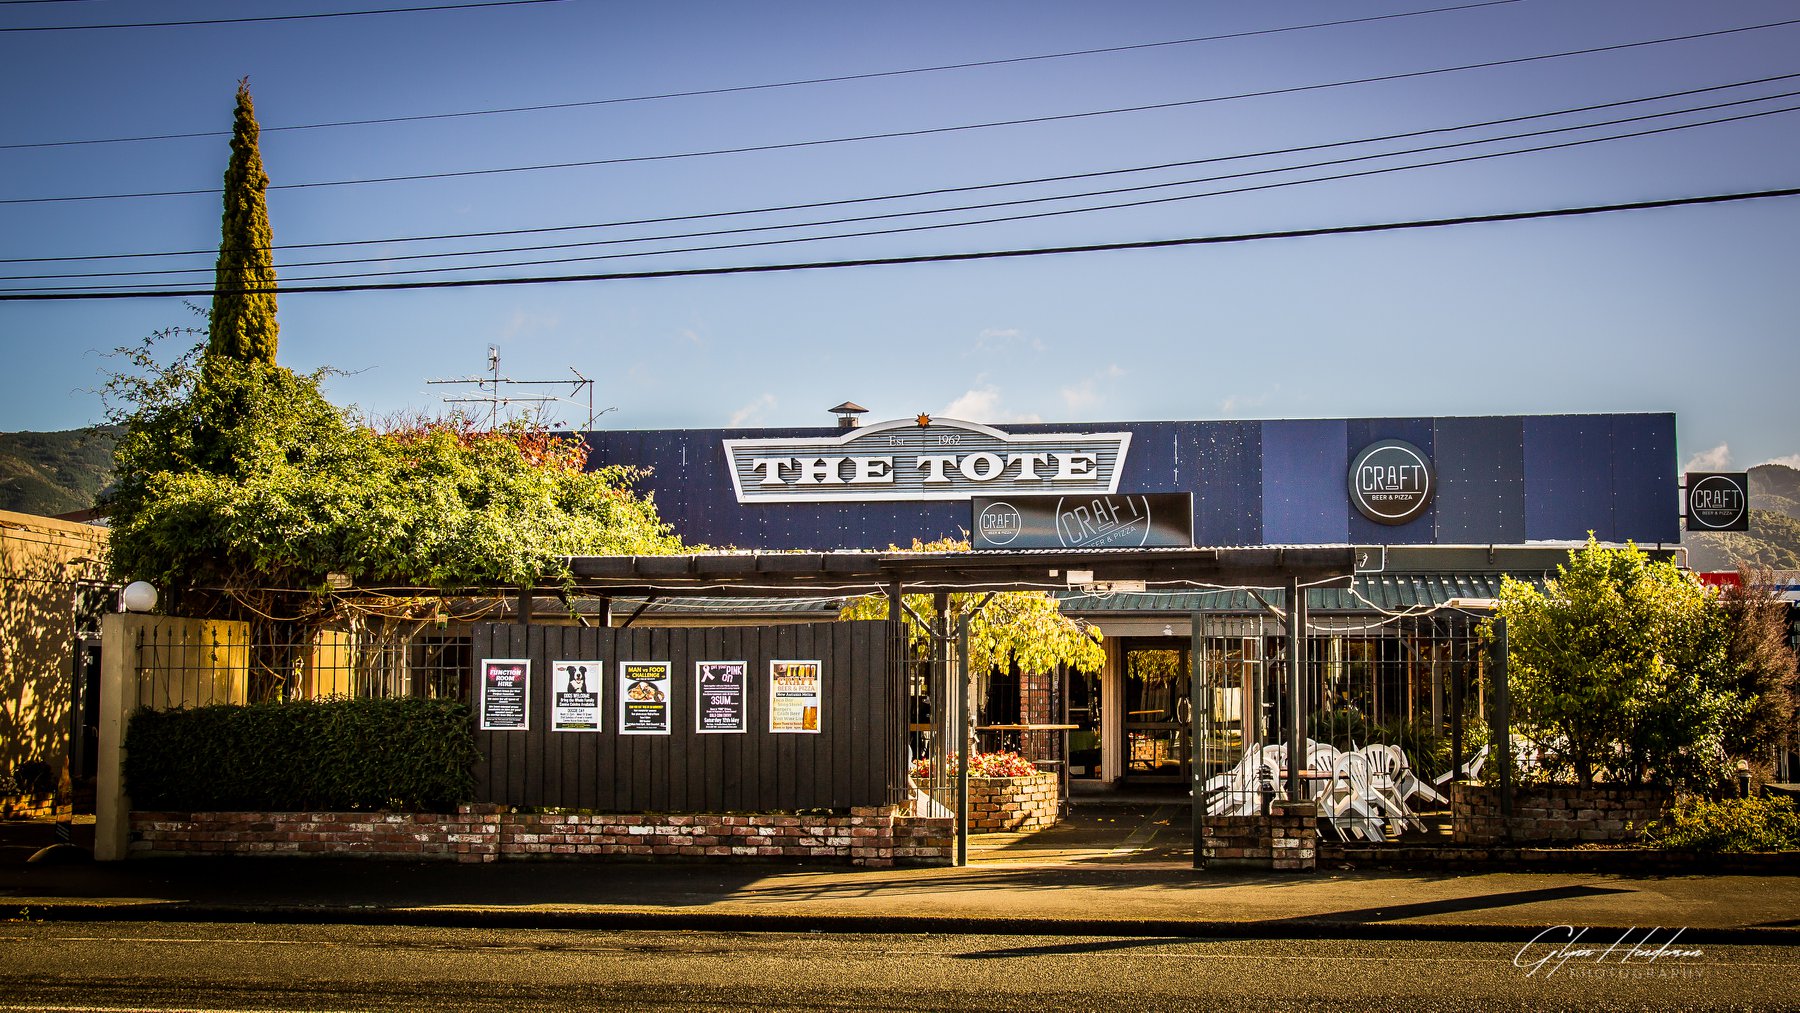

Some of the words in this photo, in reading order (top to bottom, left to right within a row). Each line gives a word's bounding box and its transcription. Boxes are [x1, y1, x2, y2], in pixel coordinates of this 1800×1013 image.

[889, 435, 905, 446] Est
[938, 434, 961, 446] 1962
[752, 456, 894, 484] THE
[916, 452, 1097, 482] TOTE
[1362, 465, 1421, 491] CRAFT
[1695, 489, 1739, 508] CRAFT
[983, 513, 1017, 529] CRAFT
[1086, 538, 1106, 548] EER
[1106, 535, 1113, 543] &
[1113, 525, 1137, 541] PIZZA
[726, 665, 743, 675] PINK
[721, 673, 734, 683] on
[777, 677, 815, 686] CRAFT
[710, 695, 731, 705] 3SUM
